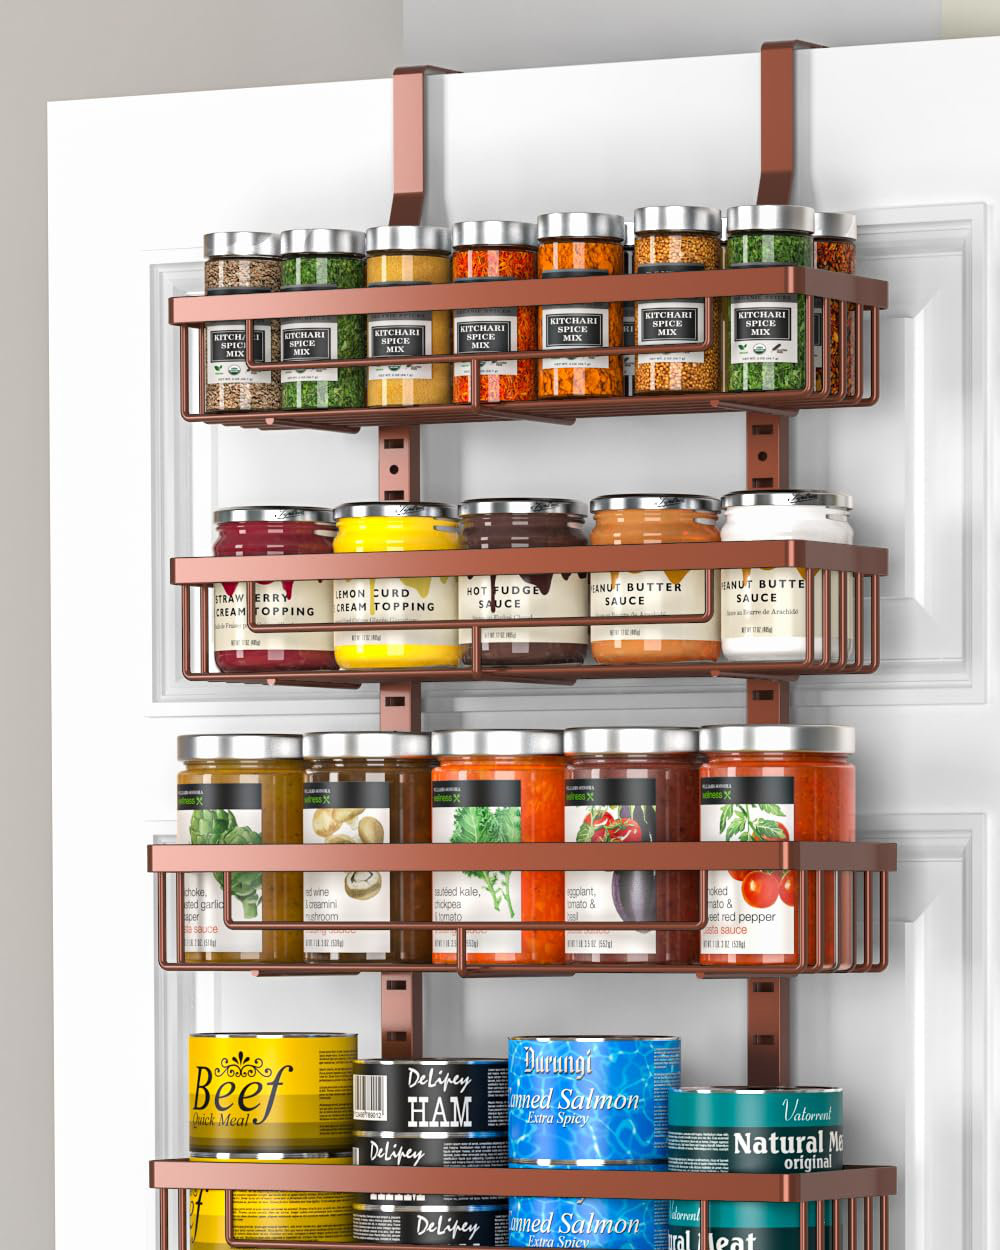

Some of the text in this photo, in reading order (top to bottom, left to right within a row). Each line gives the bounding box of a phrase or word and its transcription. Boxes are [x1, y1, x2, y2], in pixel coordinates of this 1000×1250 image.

[645, 311, 692, 319] KITCHARI
[738, 311, 786, 319] KITCHARI
[549, 317, 598, 325] KITCHARI
[652, 319, 683, 328] SPICE
[745, 319, 776, 327] SPICE
[374, 328, 420, 338] KITCHARI
[460, 324, 505, 333] KITCHARI
[557, 325, 588, 333] SPICE
[657, 328, 677, 336] MIX
[750, 328, 771, 336] MIX
[284, 331, 325, 341] KITCHARI
[381, 337, 410, 345] SPICE
[466, 333, 495, 341] SPICE
[562, 334, 582, 342] MIX
[289, 340, 316, 348] SPICE
[386, 345, 405, 353] MIX
[471, 341, 490, 349] MIX
[293, 348, 311, 356] MIX
[466, 586, 539, 596] HOT FUDGE
[627, 582, 682, 592] BUTTER
[215, 593, 288, 604] STRAWERRY
[335, 589, 410, 599] LEMON CURD
[736, 593, 777, 603] SAUCE
[478, 599, 521, 609] SAUCE
[605, 596, 645, 606] SAUCE
[216, 607, 246, 617] CREAM
[336, 602, 435, 613] CREAM TOPPING
[313, 888, 329, 897] wine
[459, 886, 481, 898] kale,
[590, 900, 596, 909] &
[727, 899, 733, 909] &
[721, 912, 776, 924] red pepper
[720, 926, 747, 935] sauce
[523, 1046, 593, 1080] Durungi
[192, 1064, 293, 1125] Beef
[558, 1088, 640, 1111] Salmon
[407, 1096, 472, 1128] HAM
[192, 1113, 249, 1129] Quick Meal
[526, 1111, 590, 1128] Extra Spicy
[733, 1129, 824, 1154] Natural
[784, 1154, 832, 1173] original
[558, 1212, 640, 1234] Salmon
[526, 1235, 590, 1248] Extra Spicy
